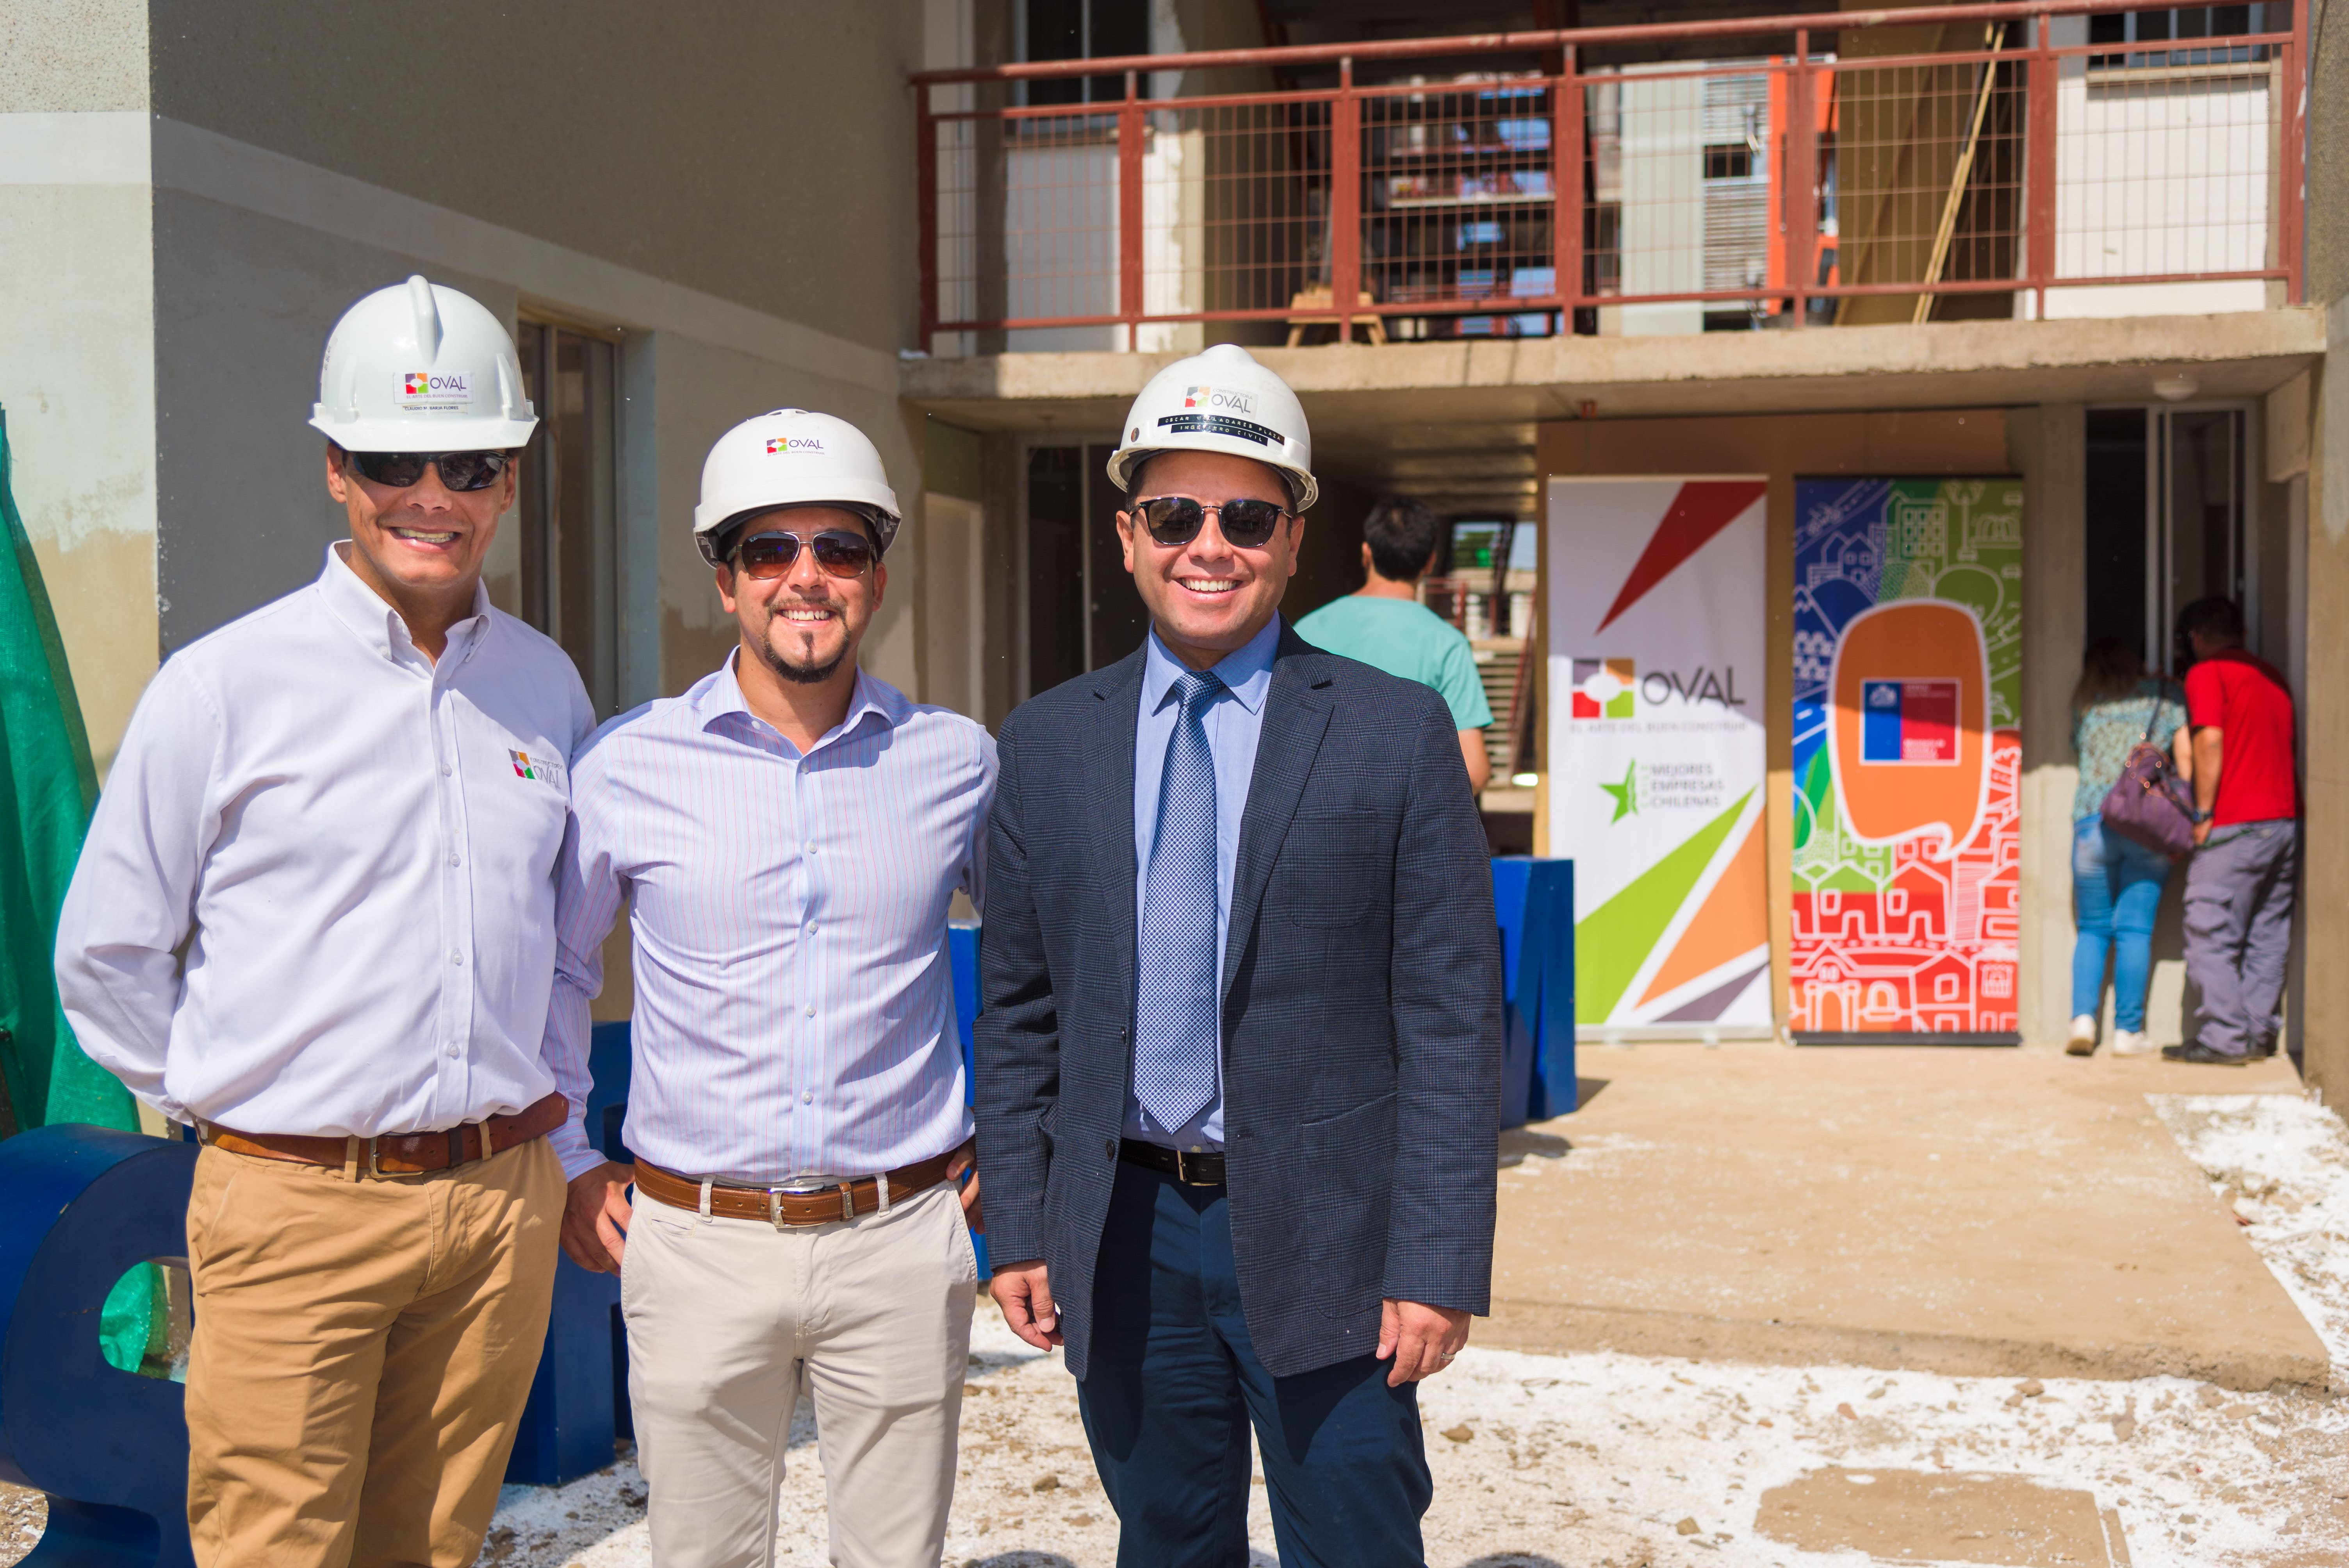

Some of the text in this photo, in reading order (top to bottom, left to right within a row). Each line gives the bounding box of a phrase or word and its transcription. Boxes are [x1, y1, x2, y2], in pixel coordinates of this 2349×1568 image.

[430, 376, 467, 391] OVAL
[1213, 388, 1253, 400] CONSTRUCTORA
[1212, 394, 1250, 413] OVAL
[1237, 431, 1262, 442] CIVIL
[1258, 428, 1280, 440] PLAZA
[789, 439, 823, 449] OVAL
[1642, 666, 1746, 709] OVAL
[534, 765, 561, 790] OVAL
